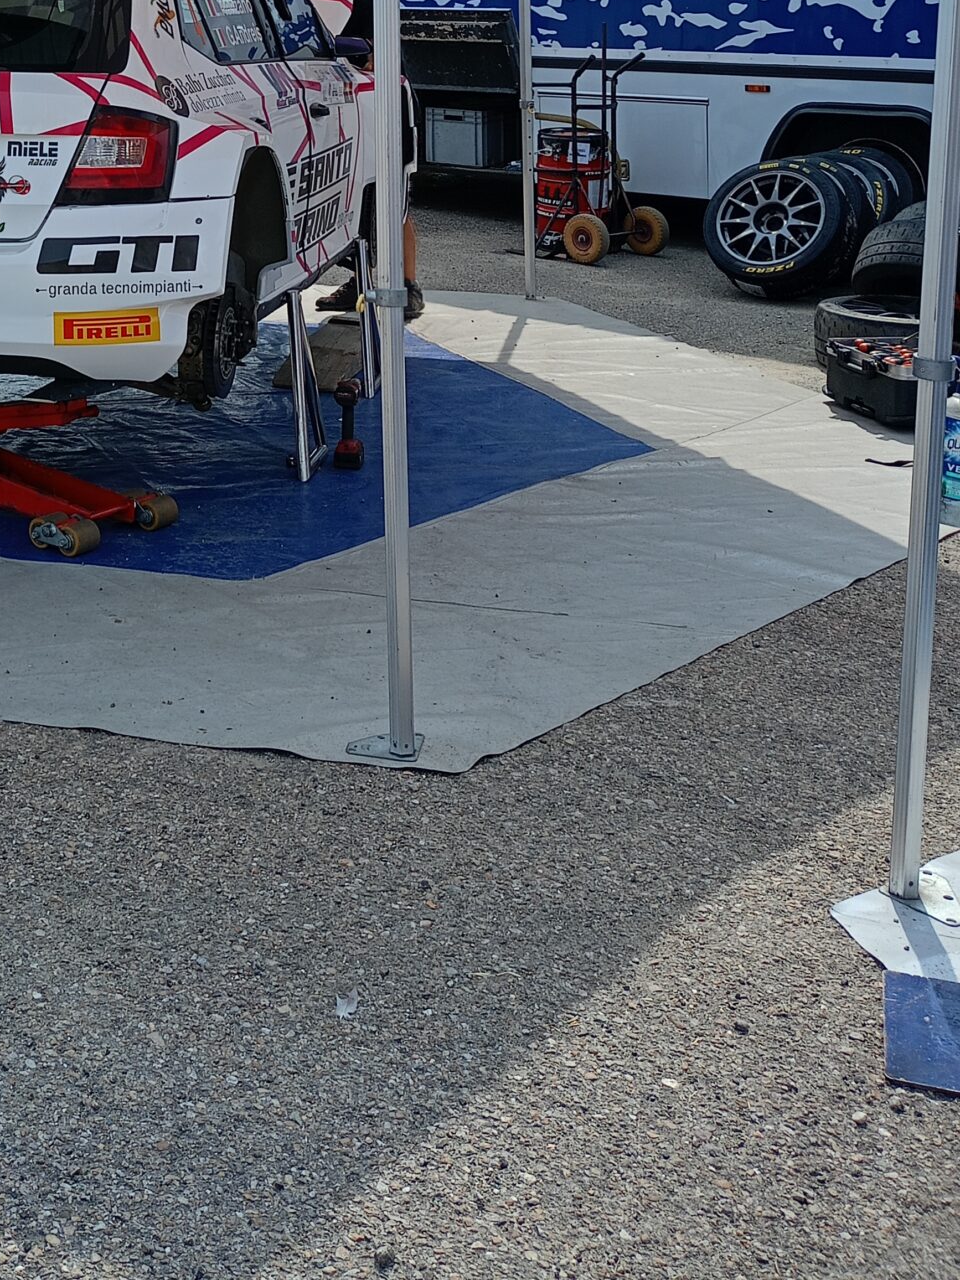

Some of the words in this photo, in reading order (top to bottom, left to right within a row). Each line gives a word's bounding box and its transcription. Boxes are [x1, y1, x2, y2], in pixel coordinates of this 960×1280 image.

[175, 72, 204, 96] Balbi
[189, 94, 224, 113] dolcezza
[27, 158, 59, 167] RACING
[298, 141, 353, 199] SANTO
[36, 234, 200, 275] GTI
[48, 281, 97, 299] granda
[101, 279, 191, 297] tecnoimpianti
[63, 315, 152, 340] PIRELLI
